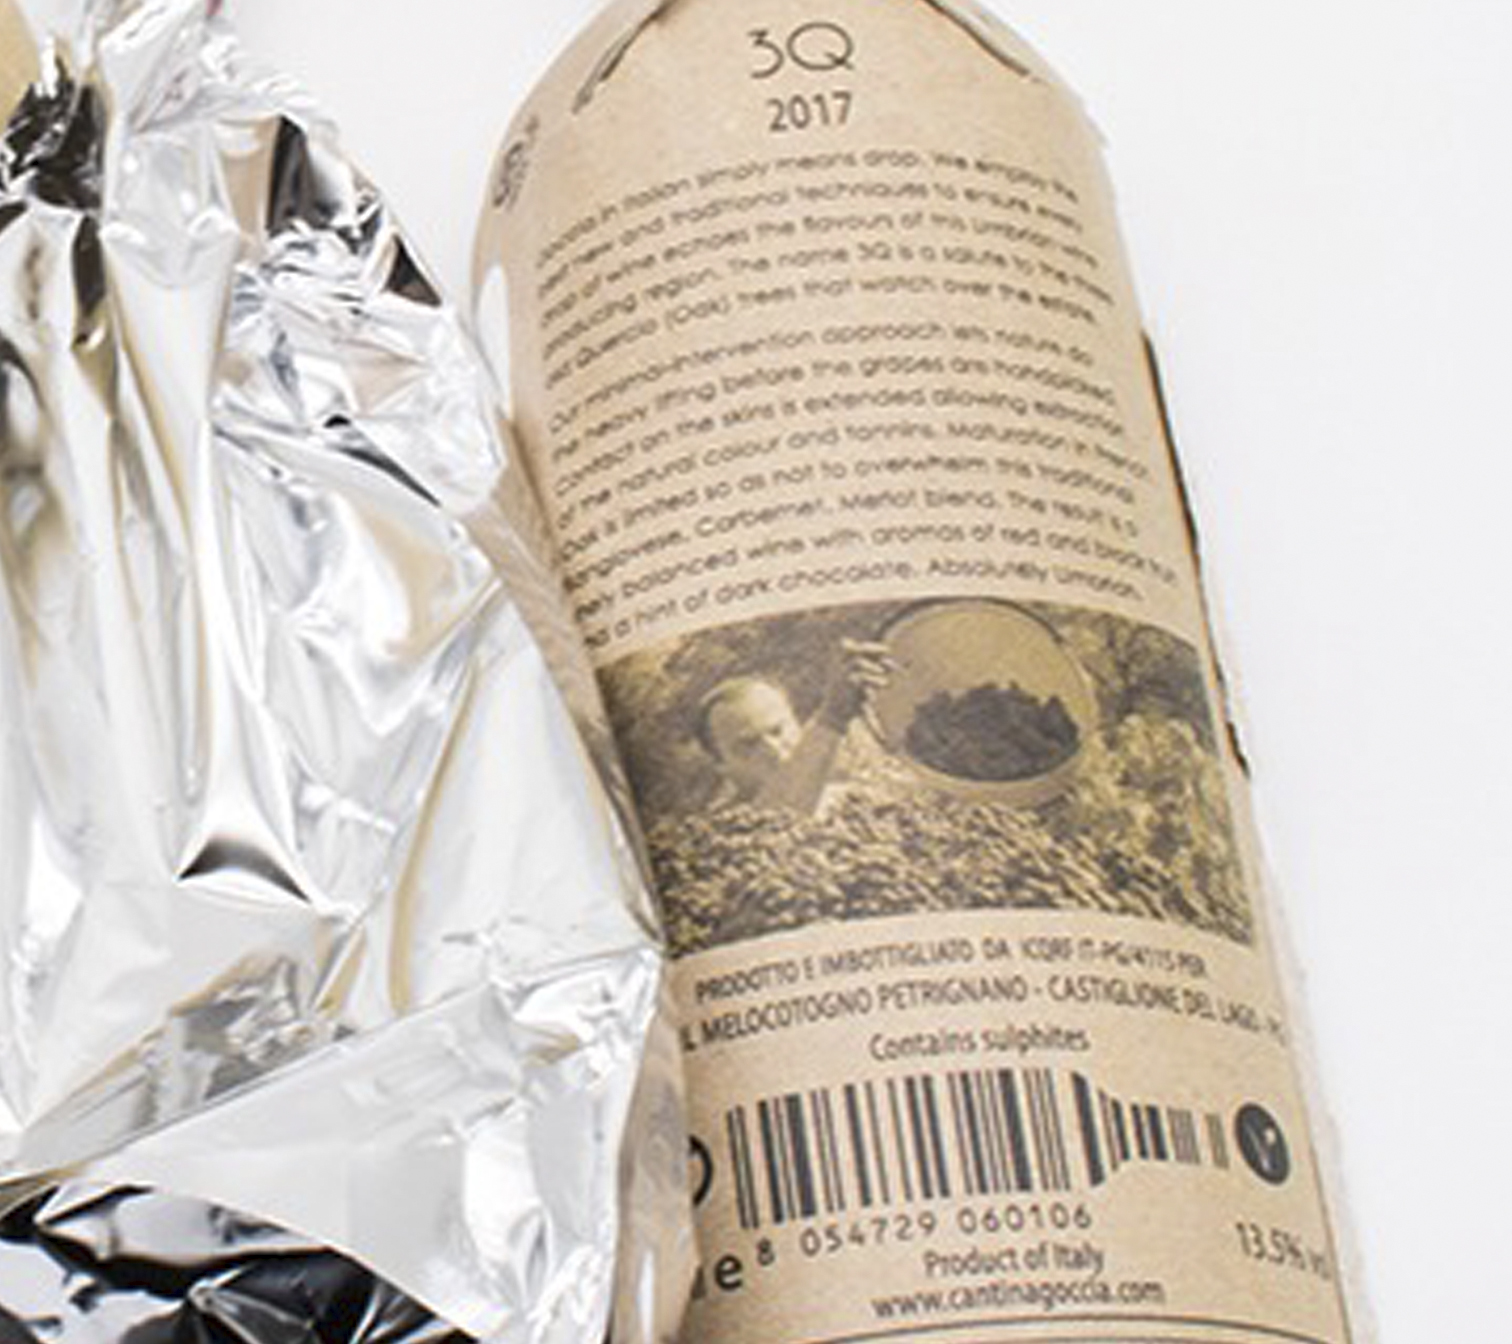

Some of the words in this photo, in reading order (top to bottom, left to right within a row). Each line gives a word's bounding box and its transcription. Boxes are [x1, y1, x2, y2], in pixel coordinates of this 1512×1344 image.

[747, 21, 855, 79] 3Q
[767, 90, 853, 132] 2017
[877, 975, 1028, 1011] PETRIGNANO
[869, 1028, 976, 1060] Contains
[981, 1023, 1091, 1055] sulphites
[756, 1240, 775, 1268] 8
[799, 1212, 937, 1256] 054729
[957, 1203, 1093, 1235] 060106
[924, 1247, 1021, 1276] Product
[1026, 1245, 1048, 1270] of
[1055, 1243, 1106, 1275] Italy
[872, 1277, 1166, 1319] www.cantinagoccia.com
